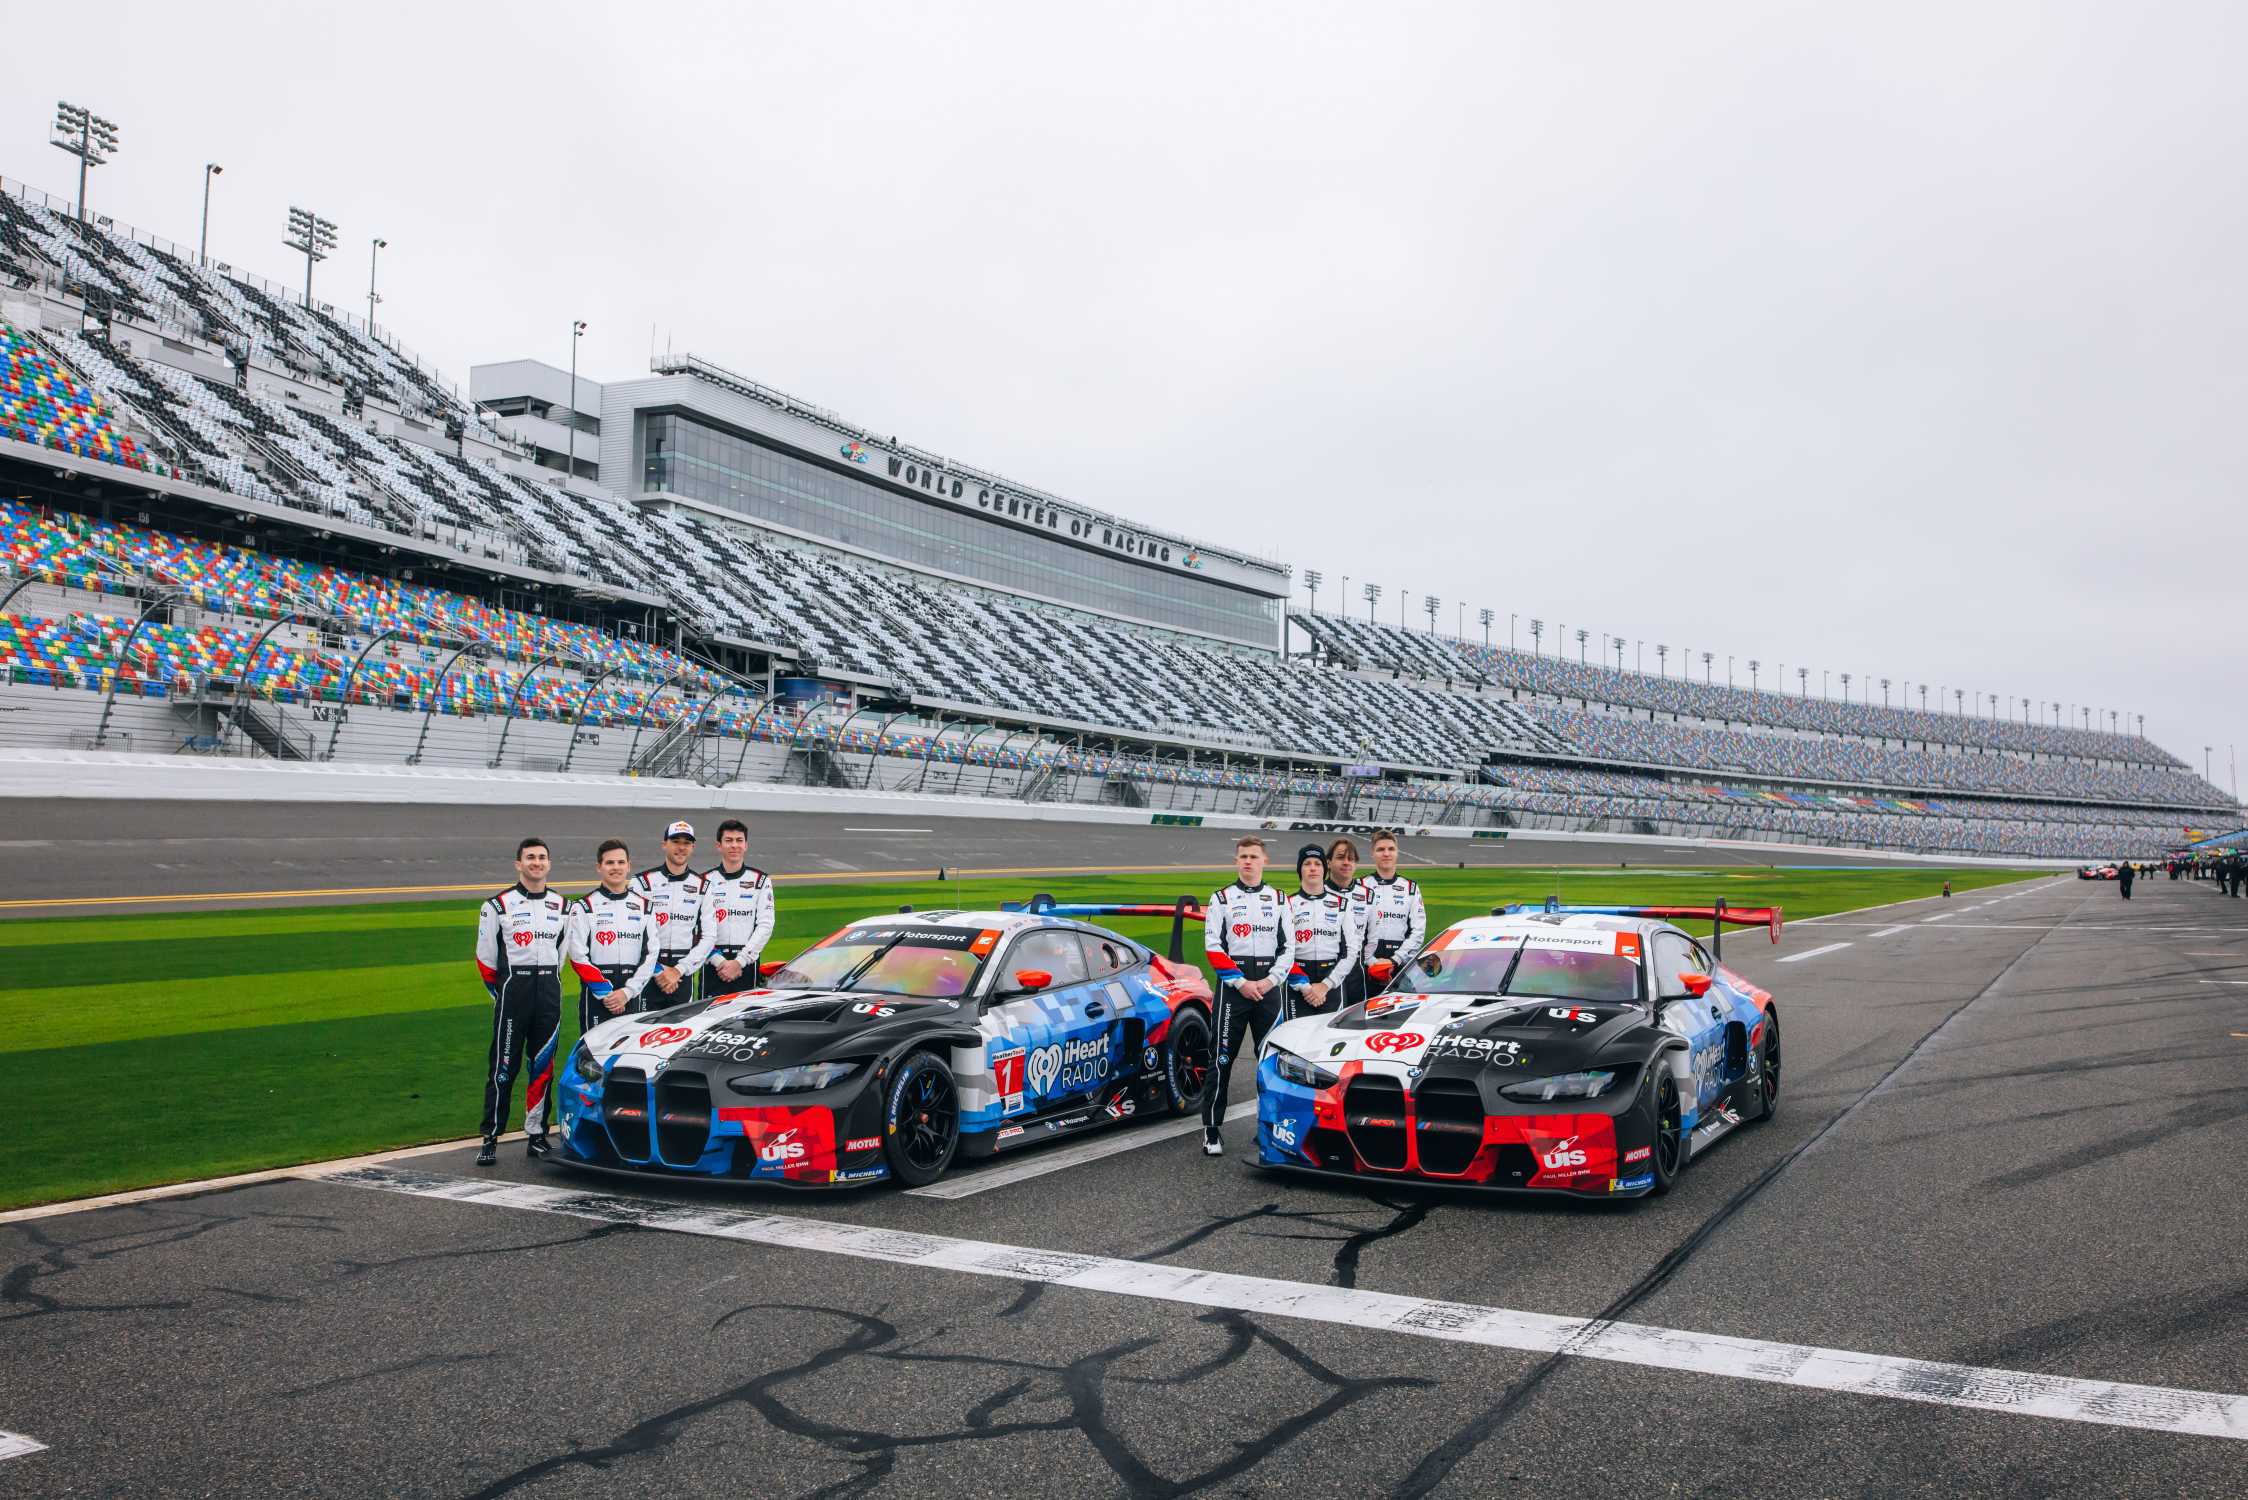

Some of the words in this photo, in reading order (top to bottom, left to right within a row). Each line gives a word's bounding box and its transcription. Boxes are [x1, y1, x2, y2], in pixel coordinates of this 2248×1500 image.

[888, 456, 964, 498] WORLD
[978, 489, 1058, 529] CENTER
[1071, 519, 1094, 539] OF
[1103, 529, 1171, 562] RACING
[1223, 1003, 1232, 1037] Motorsport
[504, 1018, 514, 1055] Motorsport
[1064, 1032, 1110, 1064] iHeart
[1430, 1035, 1520, 1054] iHeart
[1424, 1047, 1514, 1066] RADIO
[1002, 1059, 1012, 1095] 1
[1062, 1057, 1108, 1088] RADIO
[891, 1070, 909, 1115] MICHELIN
[848, 1138, 880, 1151] MOTUL
[1626, 1147, 1650, 1161] MOTUL
[848, 1169, 884, 1179] MICHELIN
